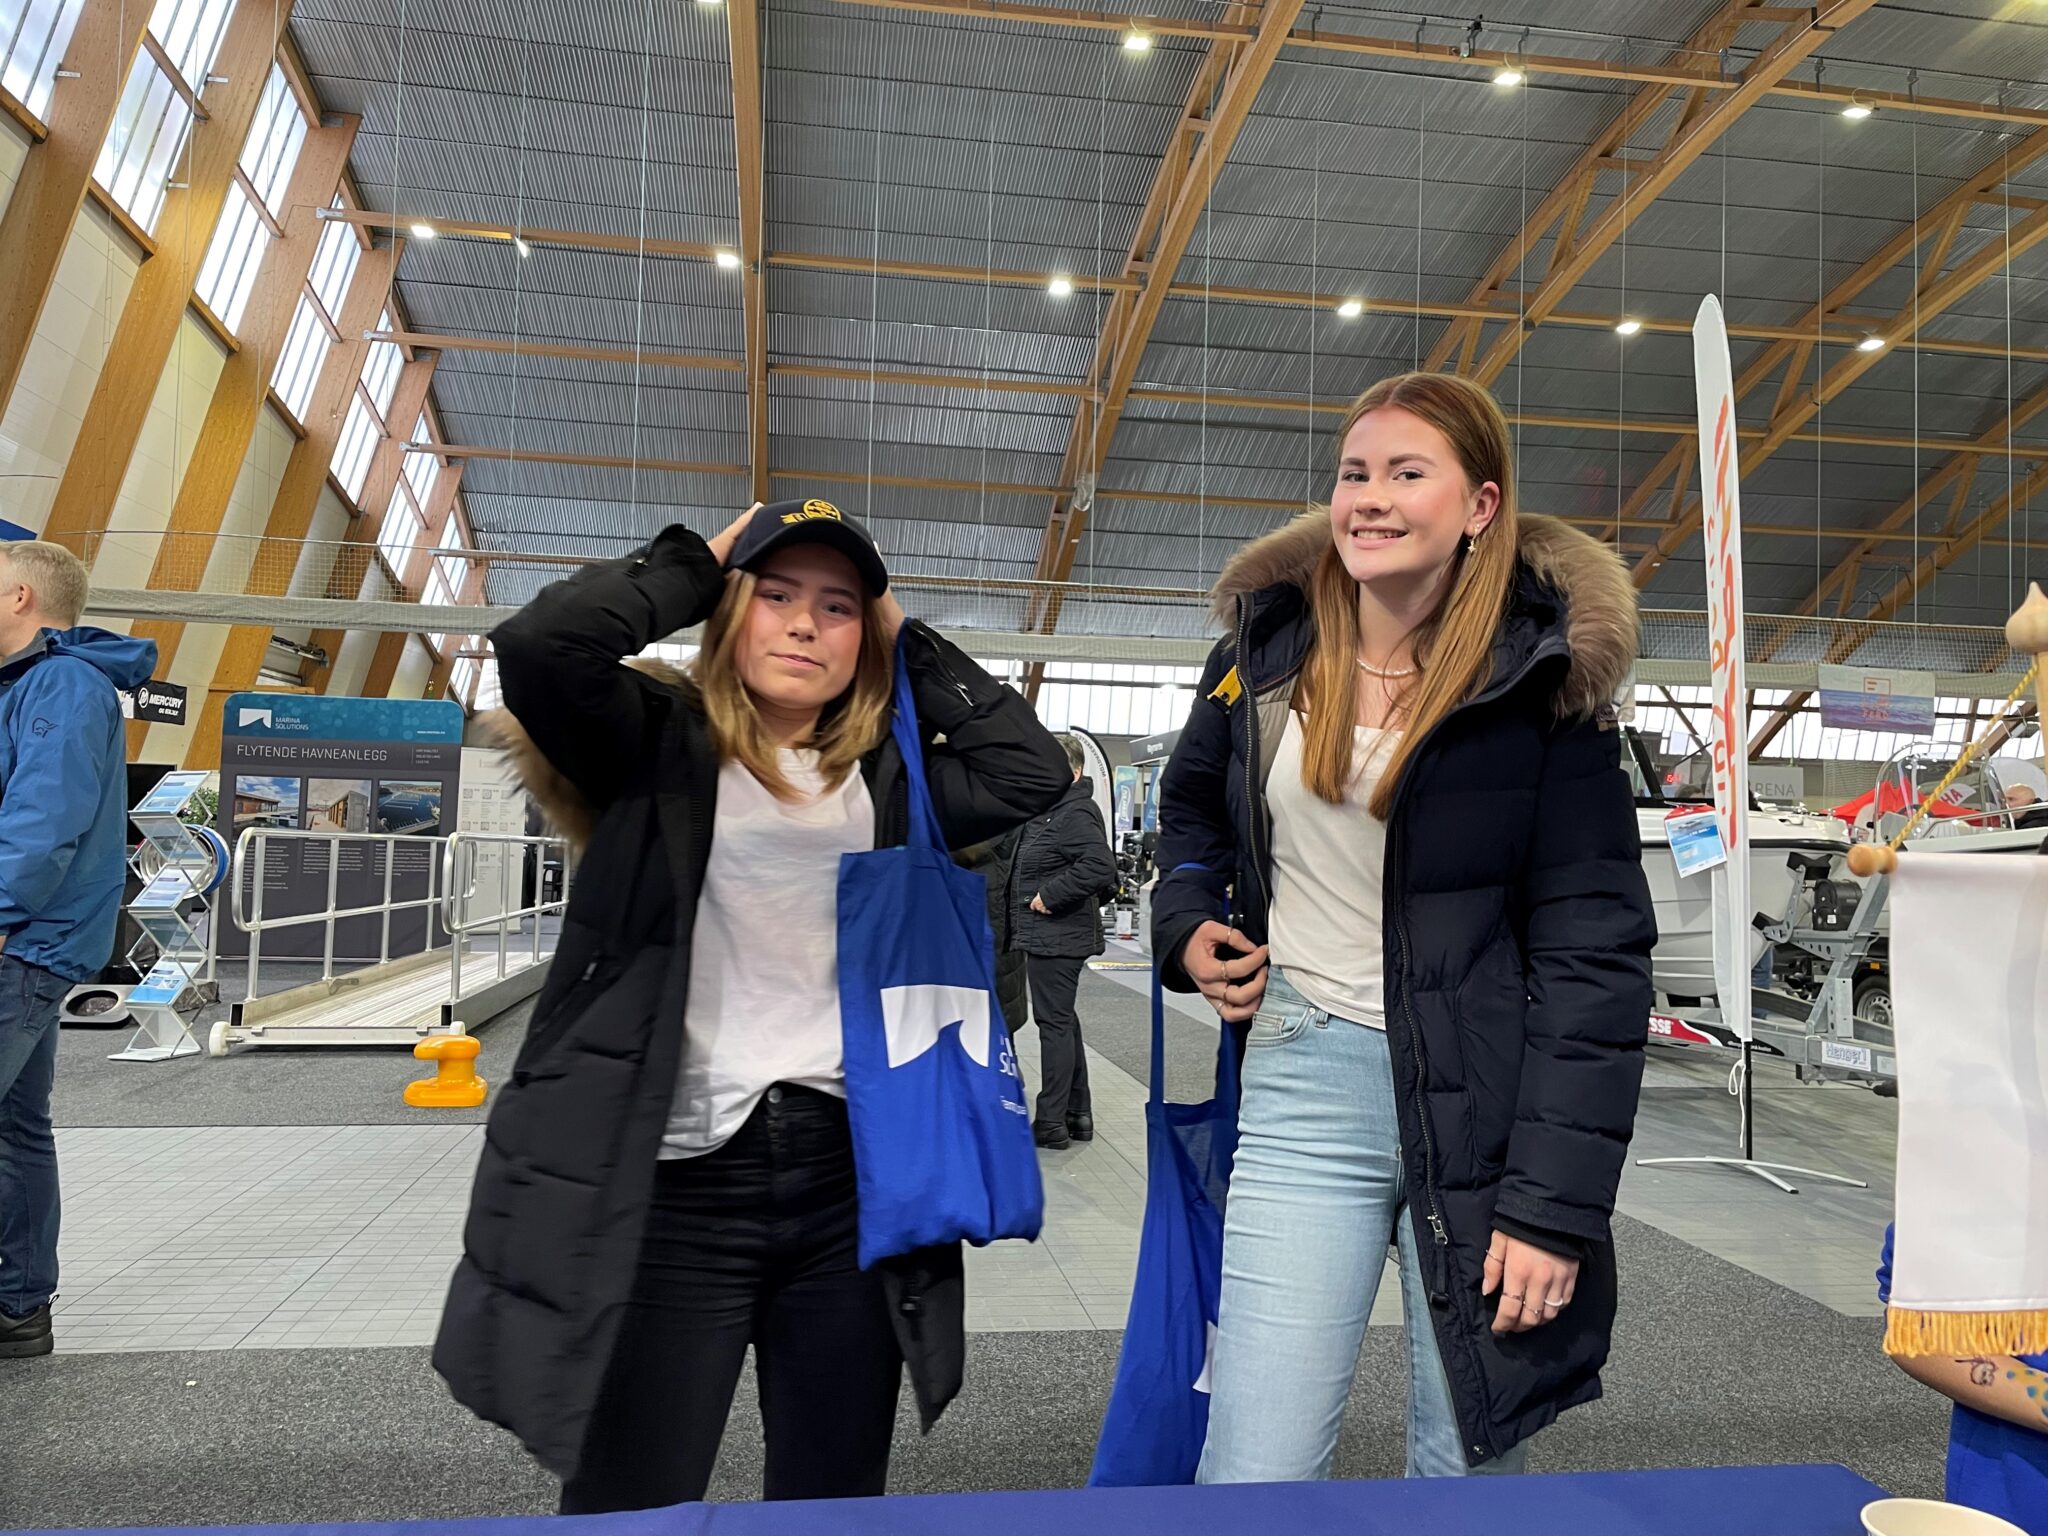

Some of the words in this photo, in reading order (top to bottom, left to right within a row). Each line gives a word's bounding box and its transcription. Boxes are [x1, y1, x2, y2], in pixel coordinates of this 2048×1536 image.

[149, 694, 183, 709] MERCURY
[275, 716, 301, 724] MARINA
[275, 723, 309, 731] SOLUTIONS
[237, 744, 297, 758] FLYTENDE
[301, 747, 388, 761] HAVNEANLEGG
[1754, 782, 1796, 797] RENA
[1940, 788, 1963, 805] HA
